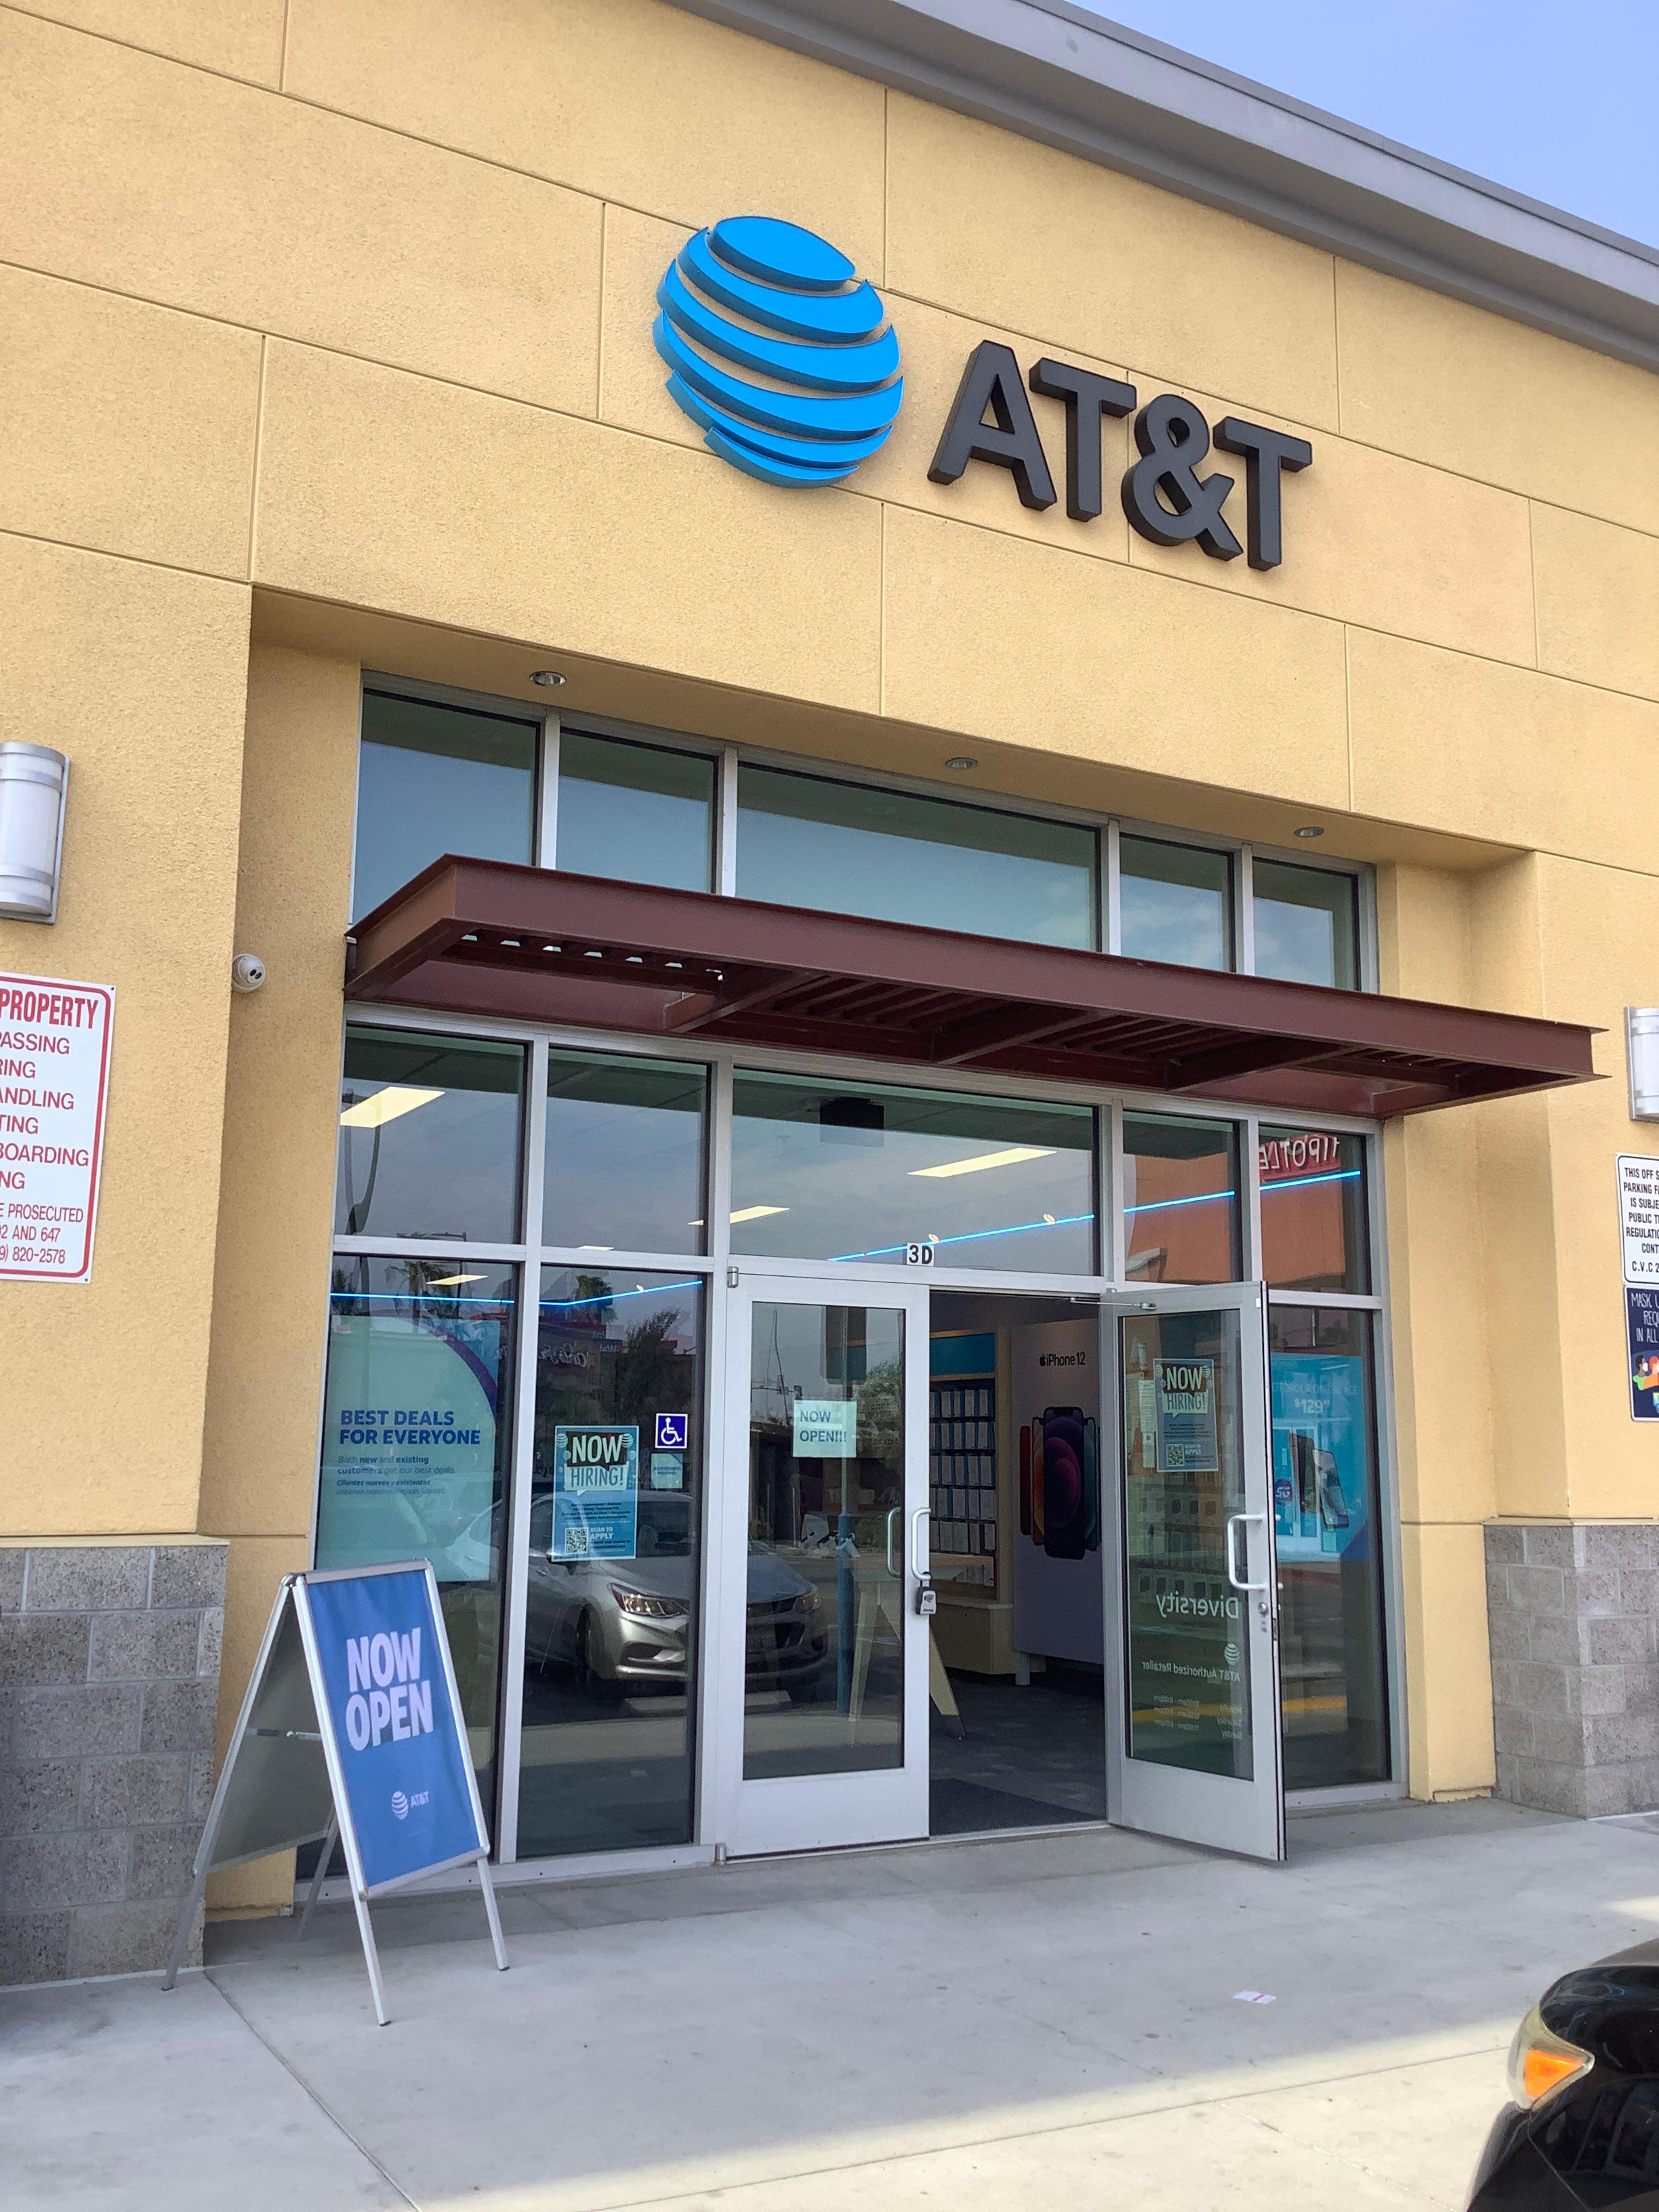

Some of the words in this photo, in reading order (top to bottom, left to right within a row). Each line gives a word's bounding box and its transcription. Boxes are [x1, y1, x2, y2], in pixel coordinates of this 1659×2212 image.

[927, 340, 1312, 571] AT&T
[0, 988, 99, 1029] PROPERTY
[0, 1031, 70, 1054] ASSING
[1624, 1167, 1640, 1179] THIS
[1641, 1169, 1654, 1180] OFF
[1623, 1182, 1652, 1194] PARKING
[1630, 1197, 1637, 1208] IS
[8, 1203, 84, 1223] PROSECUTED
[1629, 1212, 1652, 1224] PUBLIC
[12, 1225, 37, 1240] AND
[41, 1227, 61, 1242] 647
[12, 1246, 66, 1264] 820-2578
[909, 1244, 933, 1265] 3D
[1631, 1292, 1653, 1309] MASK
[1643, 1307, 1659, 1328] REQ
[1636, 1327, 1644, 1342] IN
[1646, 1328, 1658, 1343] ALL
[1046, 1353, 1076, 1367] iPhone
[1076, 1351, 1086, 1366] 12
[1166, 1366, 1203, 1391] NOW
[1166, 1393, 1206, 1410] HIRING!
[341, 1410, 390, 1425] BEST
[394, 1410, 455, 1426] DEALS
[800, 1410, 831, 1422] NOW
[340, 1429, 378, 1445] FOR
[383, 1429, 481, 1445] EVERYONE
[800, 1430, 847, 1443] OPEN!!!
[572, 1435, 622, 1464] NOW
[396, 1455, 429, 1465] existing
[384, 1467, 398, 1476] get
[414, 1467, 432, 1475] best
[571, 1467, 623, 1488] HIRING!
[1275, 1486, 1291, 1498] 5G
[347, 1627, 421, 1694] NOW
[346, 1679, 434, 1751] OPEN
[411, 1790, 430, 1808] AT&T
